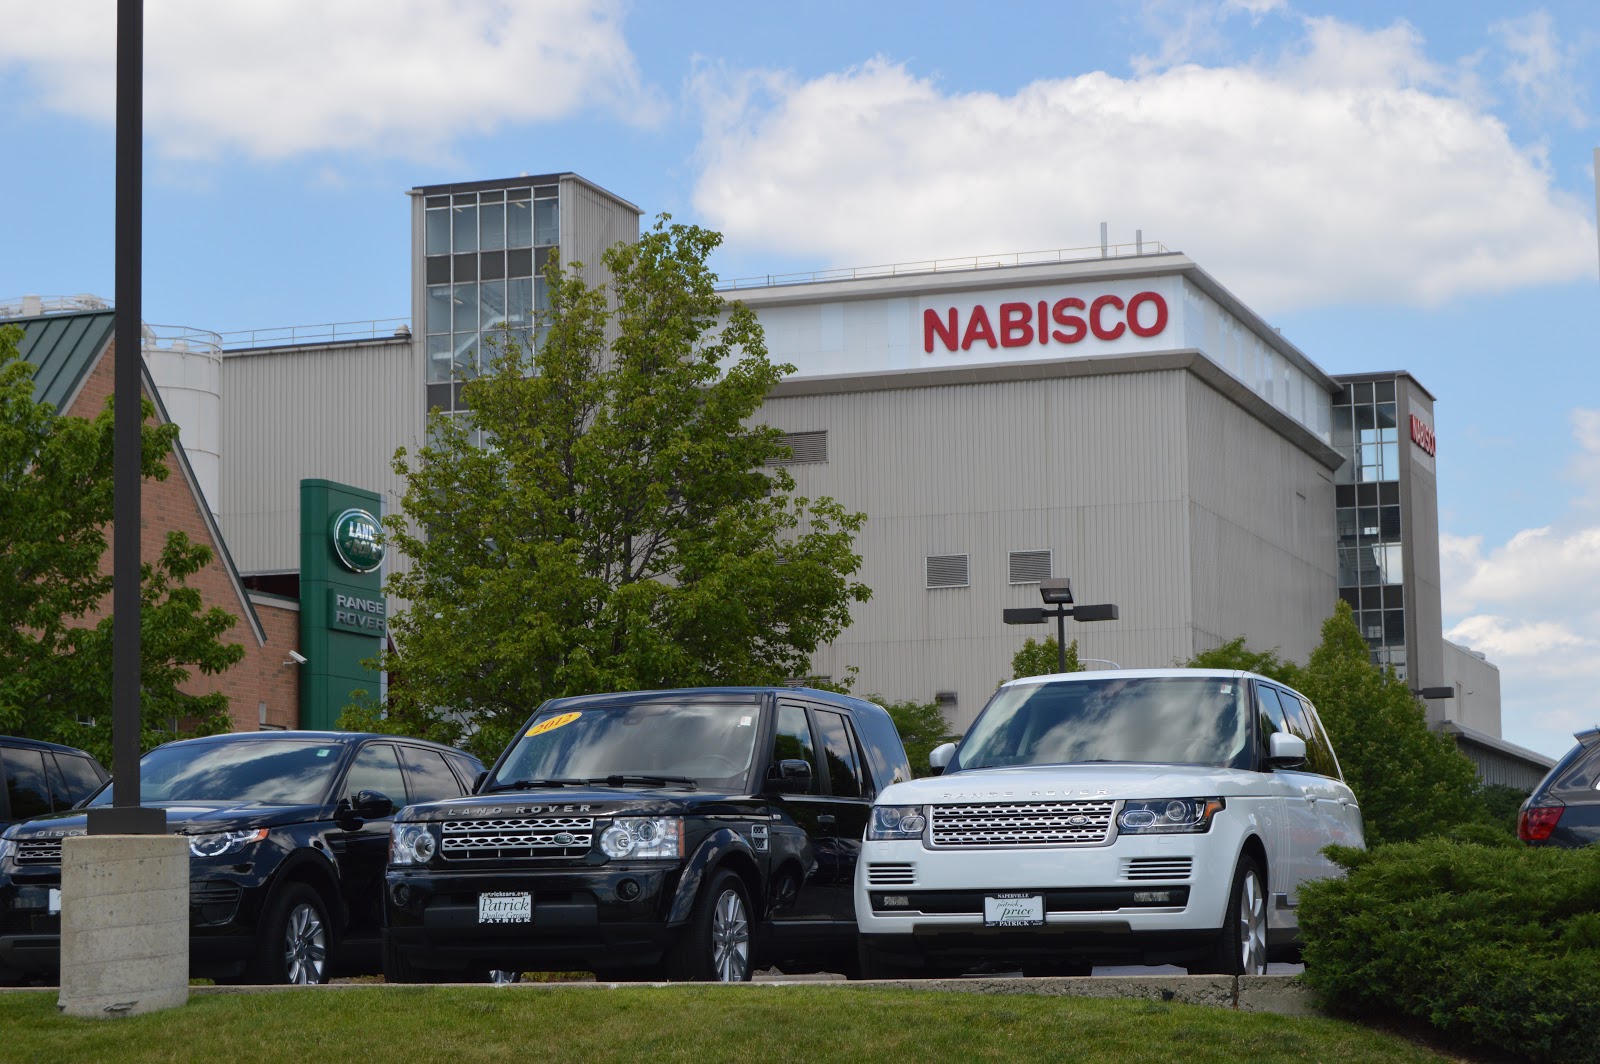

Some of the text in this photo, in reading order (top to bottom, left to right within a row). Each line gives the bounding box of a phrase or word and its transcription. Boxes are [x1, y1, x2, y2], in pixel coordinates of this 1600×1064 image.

[924, 291, 1168, 353] NABISCO
[349, 521, 375, 540] LAND
[336, 594, 385, 615] RANGE
[336, 611, 385, 630] ROVER
[941, 789, 1108, 800] RANGE ROVER
[447, 804, 591, 816] LAND ROVER
[481, 897, 529, 911] Patrick
[1000, 907, 1033, 921] price
